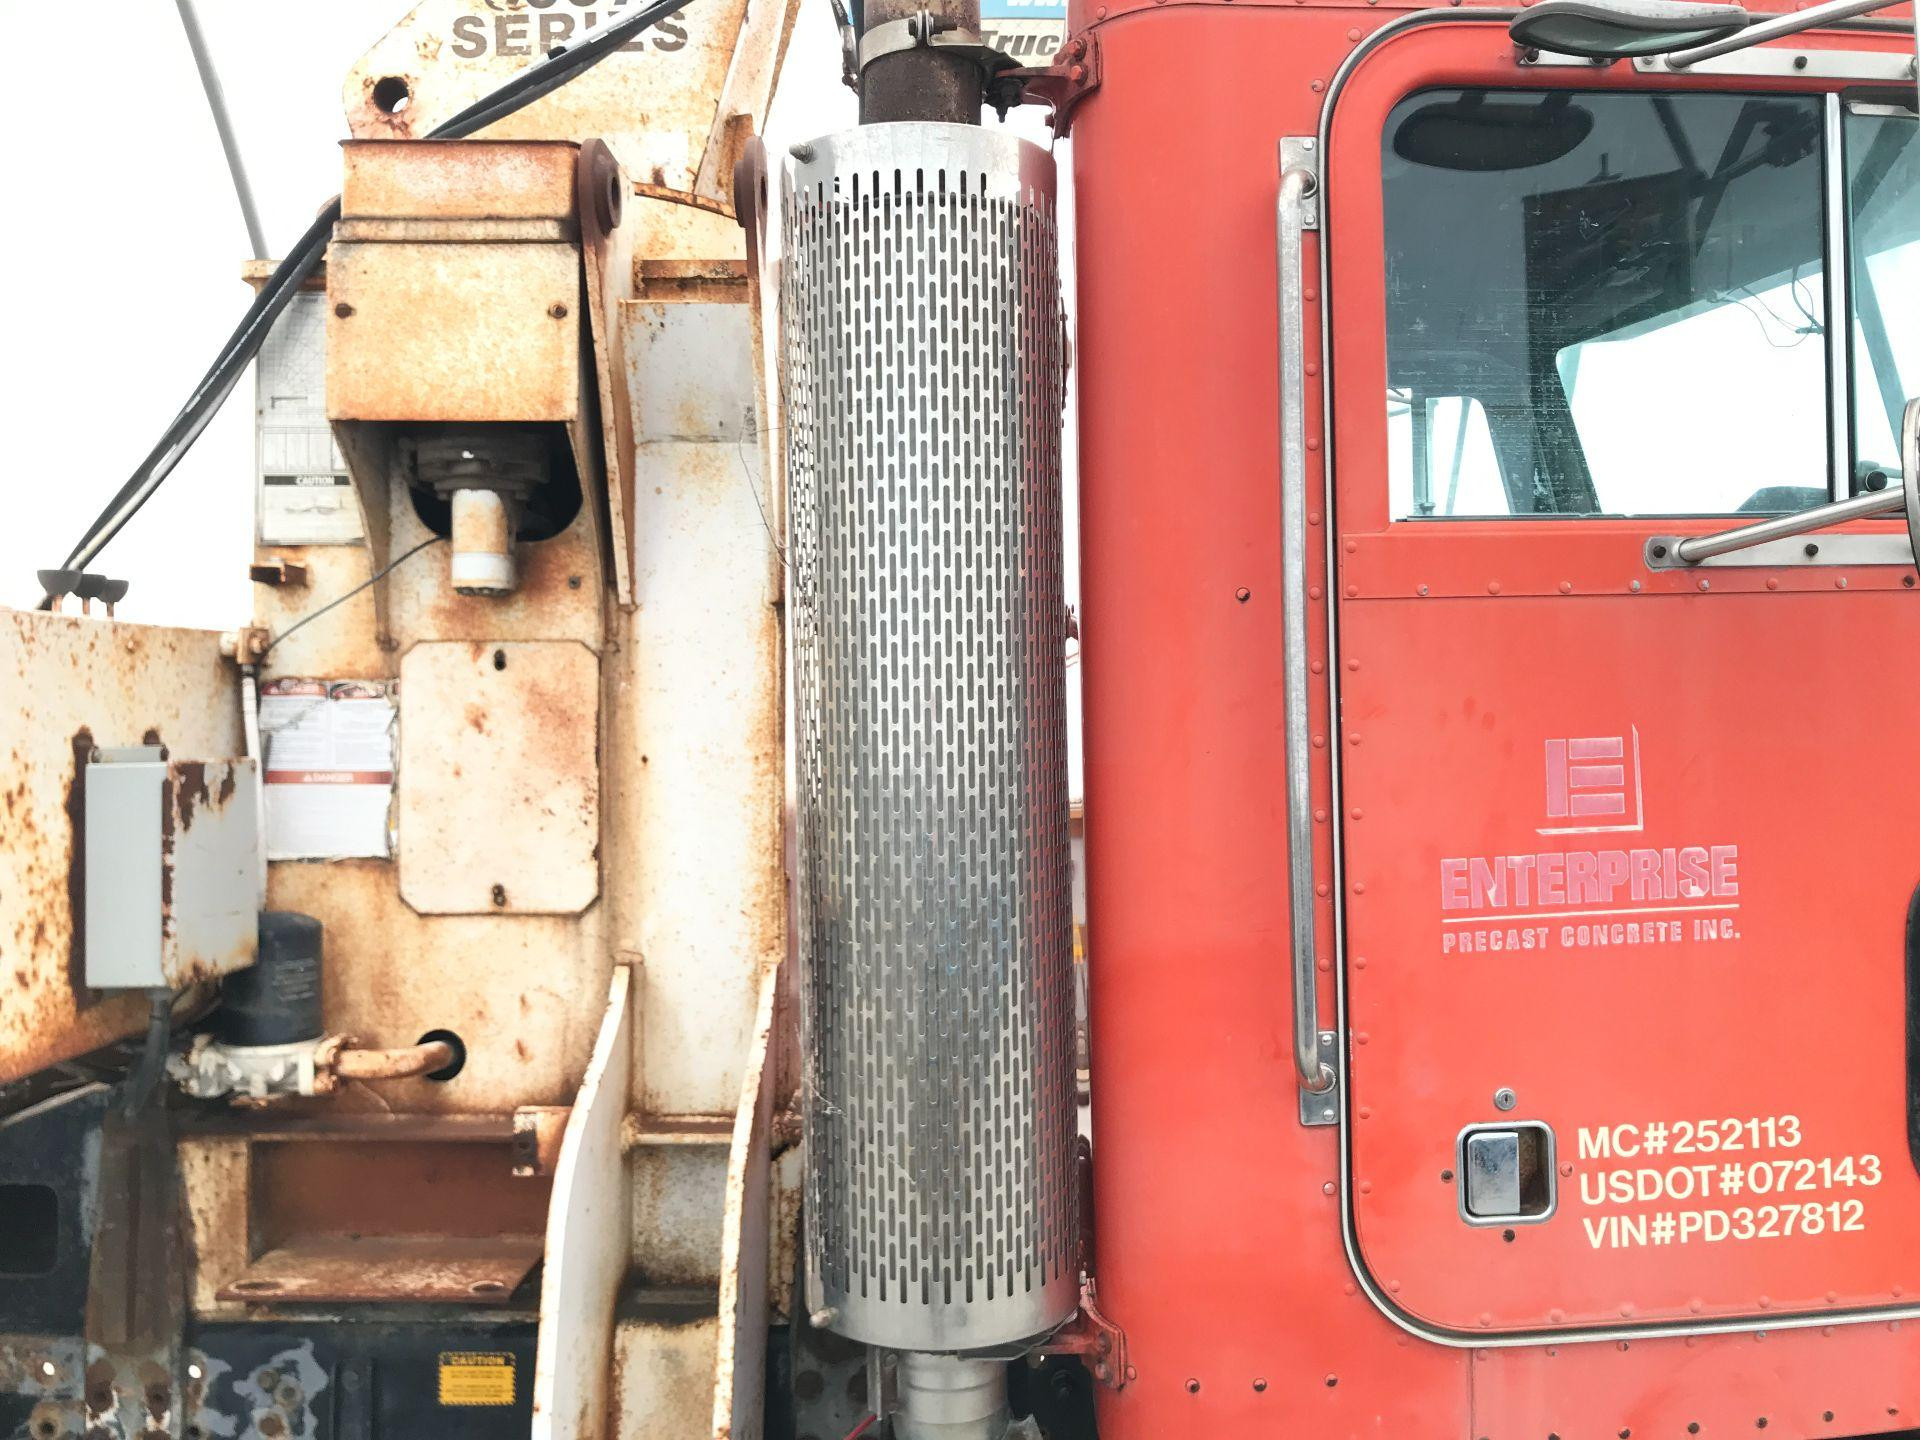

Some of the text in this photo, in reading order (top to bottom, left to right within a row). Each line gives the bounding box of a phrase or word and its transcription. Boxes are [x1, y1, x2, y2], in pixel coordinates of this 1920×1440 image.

[296, 474, 335, 486] CAUTION
[314, 772, 354, 783] DANGER
[1440, 845, 1739, 909] ENTERPRISE
[1443, 918, 1741, 953] PRECAST CONCRETE INC.
[1578, 1115, 1802, 1159] MC#252113
[1580, 1154, 1882, 1205] USDOT#072143
[1583, 1199, 1865, 1249] VIN#PD327812
[451, 1356, 505, 1366] CAUTION
